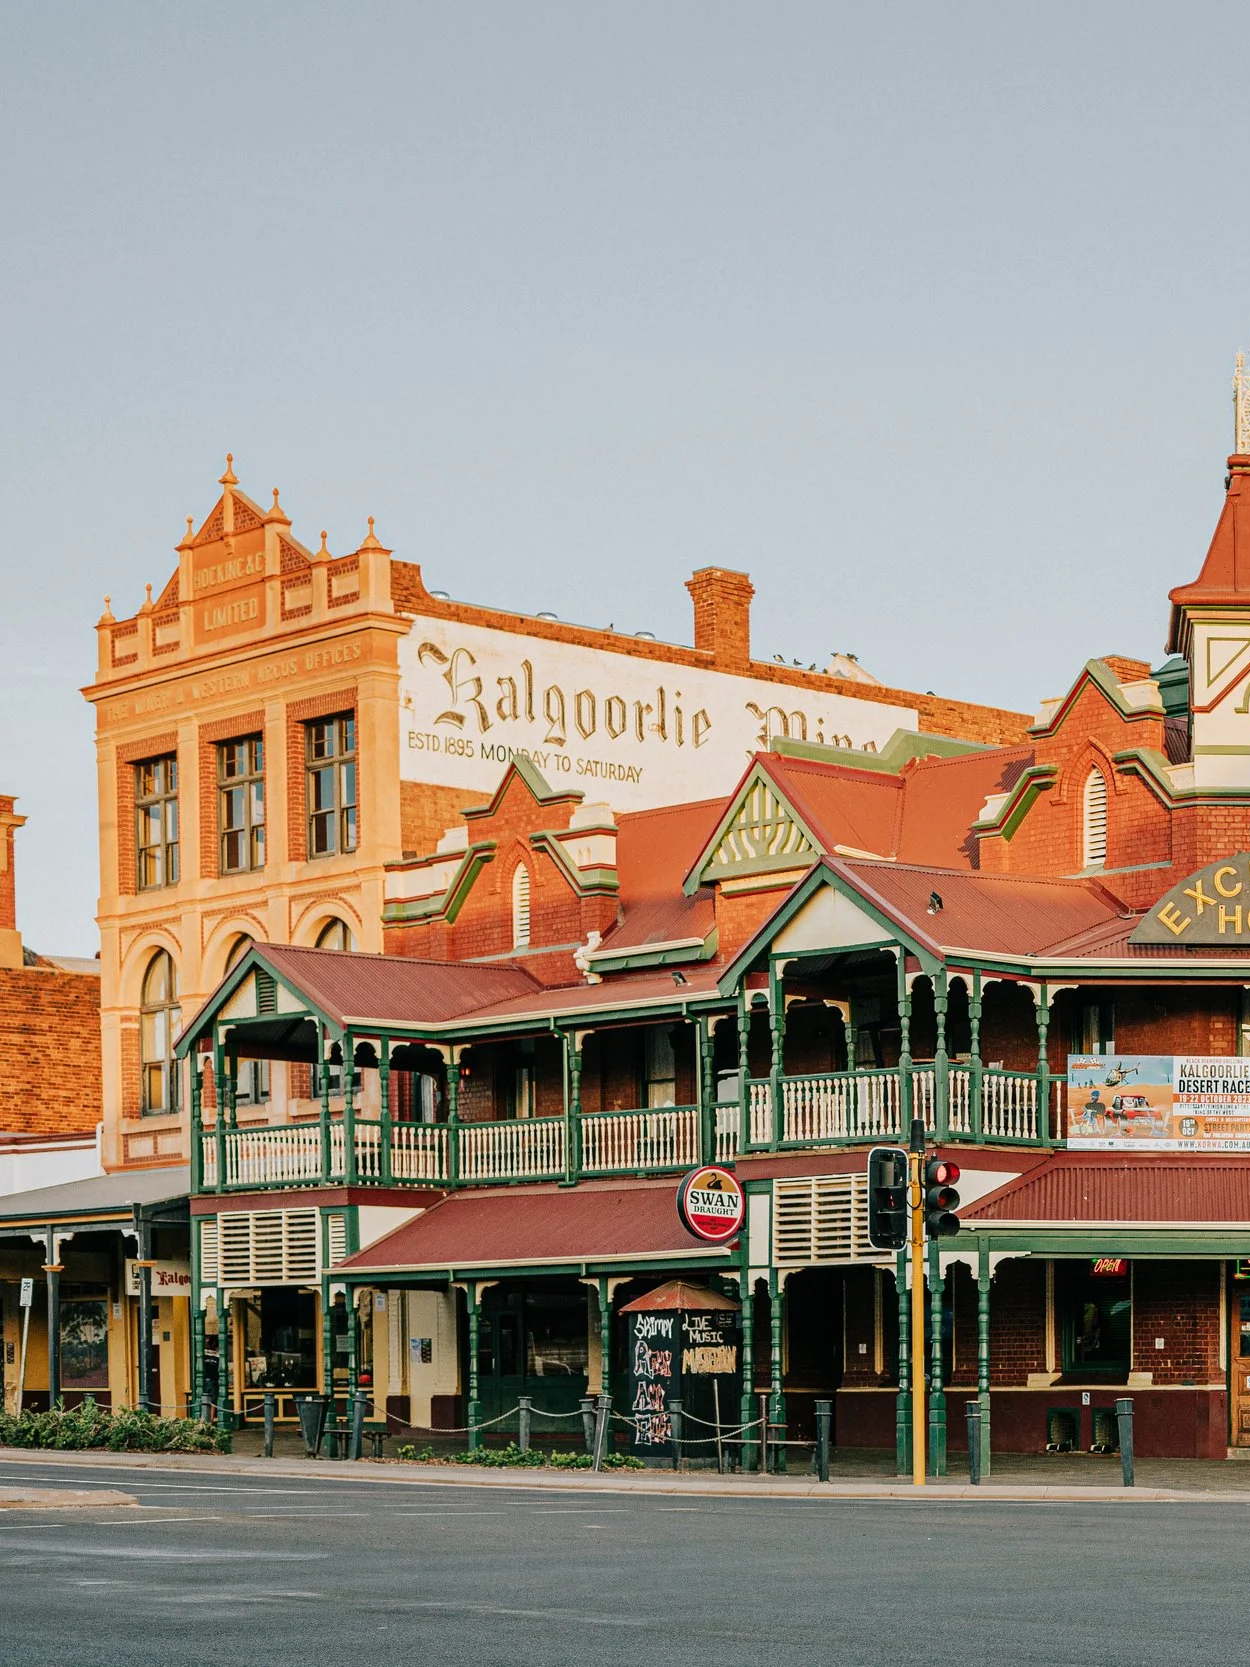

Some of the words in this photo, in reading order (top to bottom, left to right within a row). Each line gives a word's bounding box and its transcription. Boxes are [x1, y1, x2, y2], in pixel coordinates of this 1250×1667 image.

[203, 598, 258, 632] LIMITED
[305, 642, 361, 672] OFFICES
[417, 641, 712, 750] Kalgoorlie
[554, 753, 572, 774] TO
[576, 757, 643, 784] SATURDAY
[1180, 1064, 1250, 1079] KALGOORLIE
[1178, 1080, 1220, 1094] DESERT
[1222, 1080, 1250, 1094] RACE
[1179, 1094, 1199, 1103] 19-22
[1200, 1094, 1232, 1103] OCTOBER
[1203, 1123, 1230, 1132] STREET
[690, 1190, 739, 1208] SWAN
[694, 1206, 735, 1216] DRAUGHT
[1094, 1258, 1122, 1273] OPEN
[682, 1313, 712, 1331] LIVE
